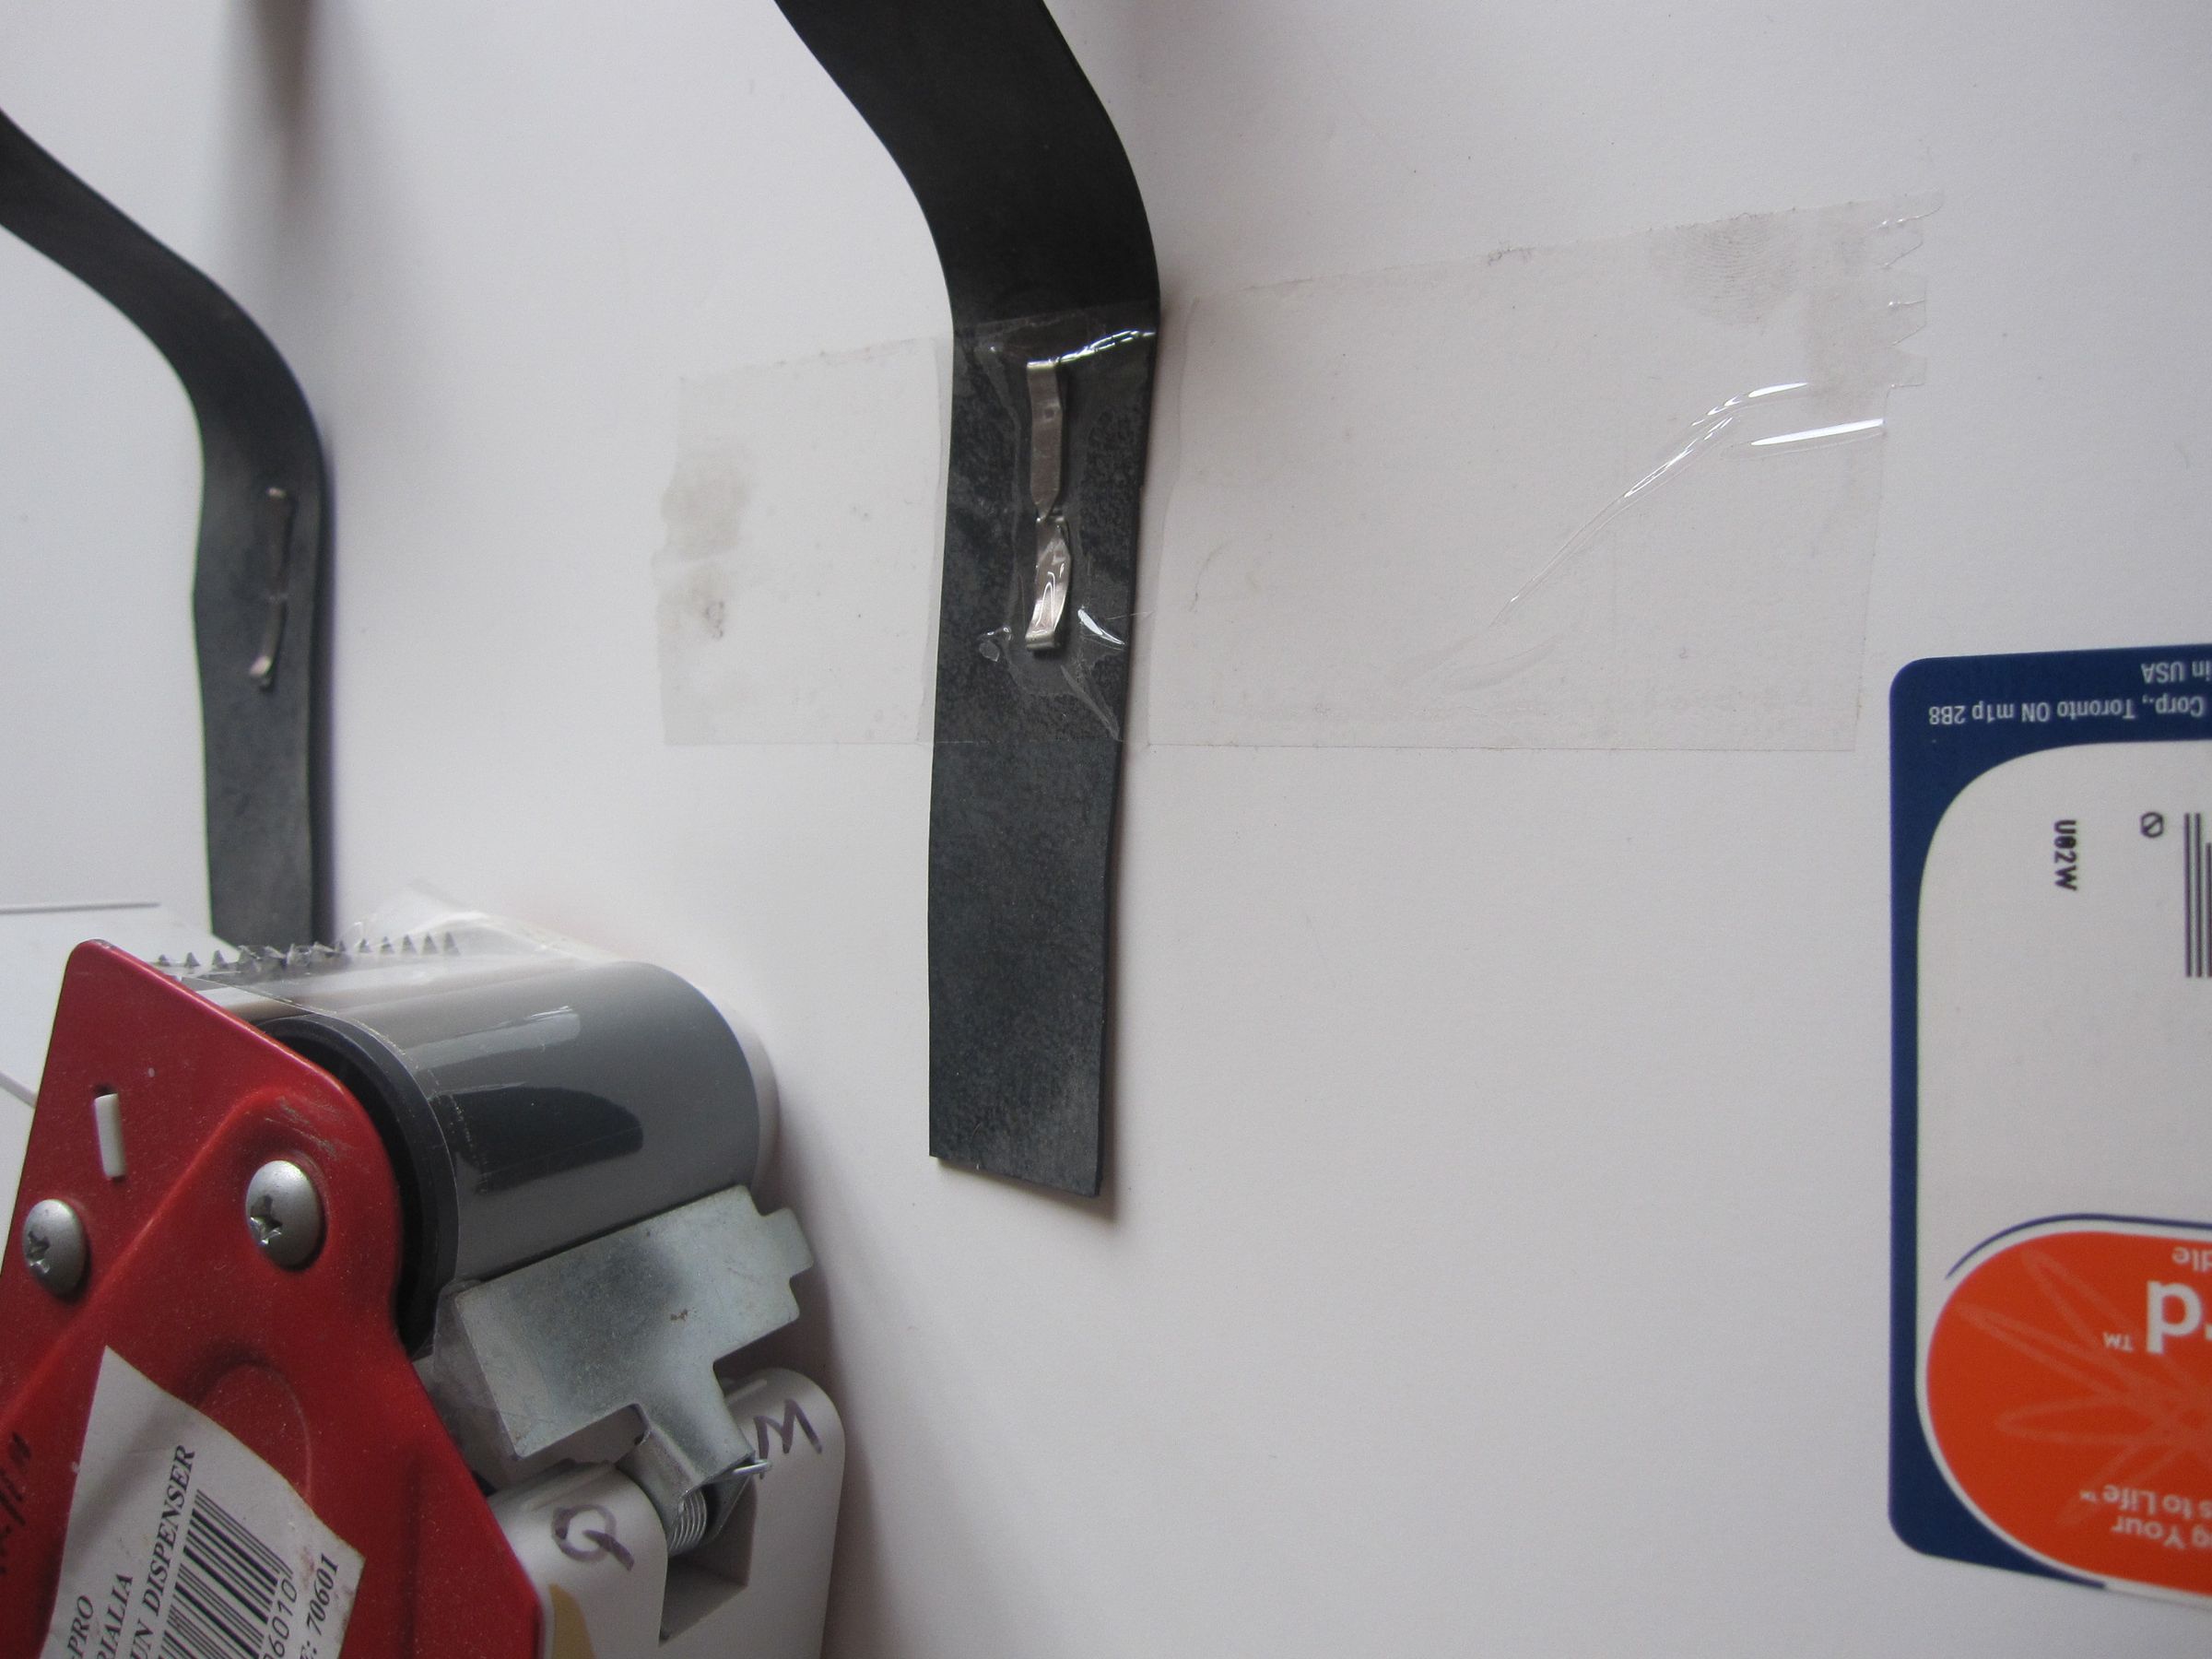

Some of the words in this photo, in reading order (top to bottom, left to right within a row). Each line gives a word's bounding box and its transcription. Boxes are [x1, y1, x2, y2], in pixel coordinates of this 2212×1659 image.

[2141, 661, 2185, 684] USA
[1928, 704, 1966, 725] 2B8
[1971, 700, 2015, 724] m1p
[2020, 700, 2051, 724] ON
[2056, 698, 2136, 720] Toronto
[2142, 693, 2206, 718] Corp.,
[2146, 1279, 2212, 1356] d
[753, 1399, 824, 1479] M
[2161, 1493, 2193, 1520] to
[142, 1444, 195, 1617] DISPENSER
[551, 1504, 636, 1571] Q
[2111, 1515, 2186, 1549] Your
[306, 1552, 339, 1636] 70601
